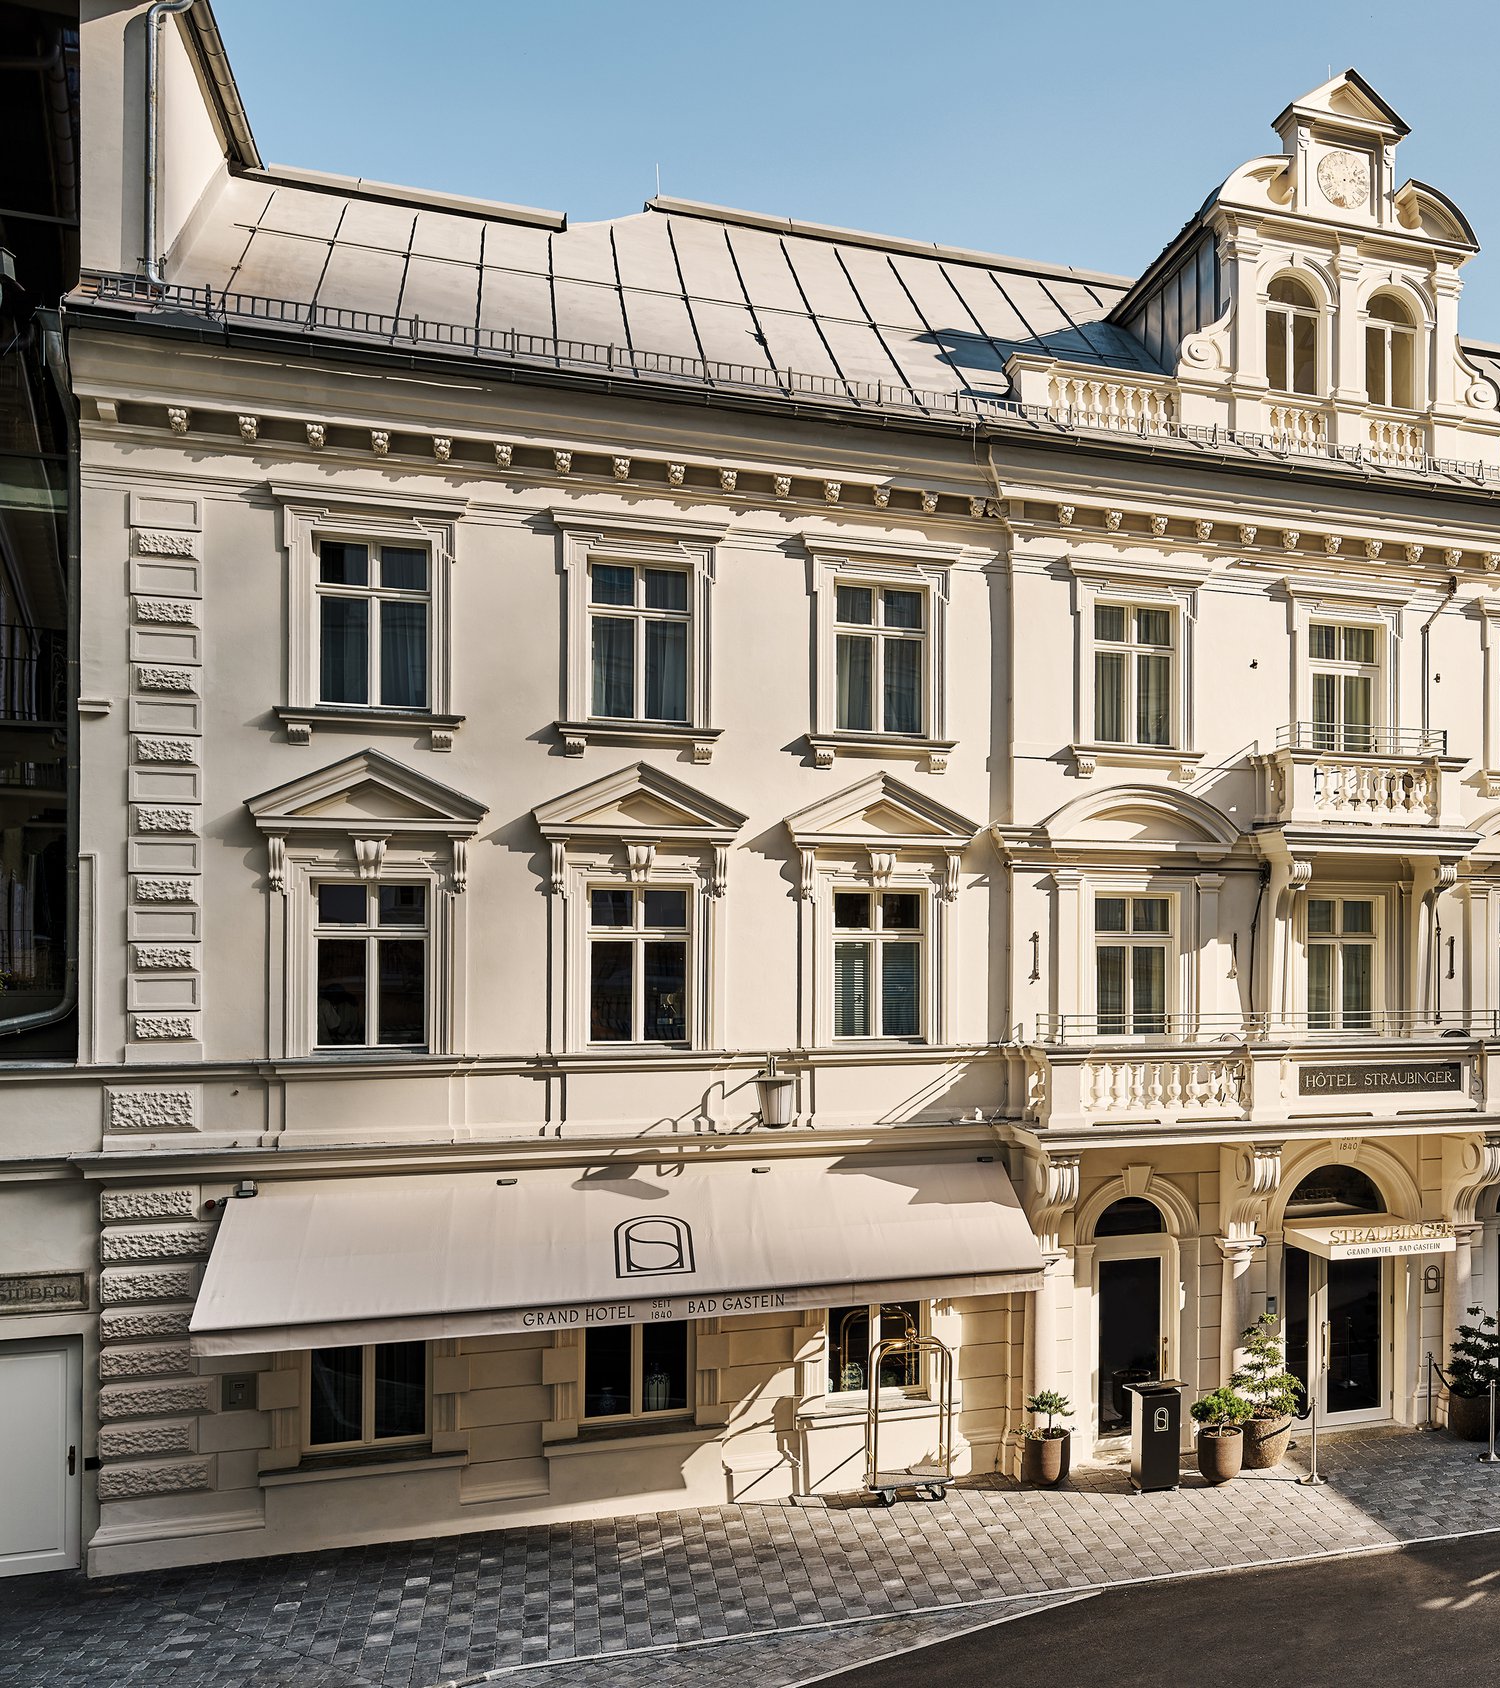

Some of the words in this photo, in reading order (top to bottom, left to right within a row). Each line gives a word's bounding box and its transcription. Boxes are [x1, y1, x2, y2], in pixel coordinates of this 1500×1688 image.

[1306, 1072, 1356, 1088] HÔTEL
[1329, 1222, 1456, 1244] STRAUBINGER
[1346, 1248, 1370, 1257] GRAND
[1371, 1246, 1392, 1255] HOTEL
[1399, 1245, 1412, 1253] BAD
[1413, 1242, 1441, 1252] GASTEIN
[652, 1299, 672, 1309] SEIT
[687, 1299, 717, 1314] BAD
[722, 1293, 786, 1311] GASTEIN
[523, 1310, 579, 1327] GRAND
[585, 1305, 636, 1322] HOTEL
[651, 1310, 673, 1320] 1840
